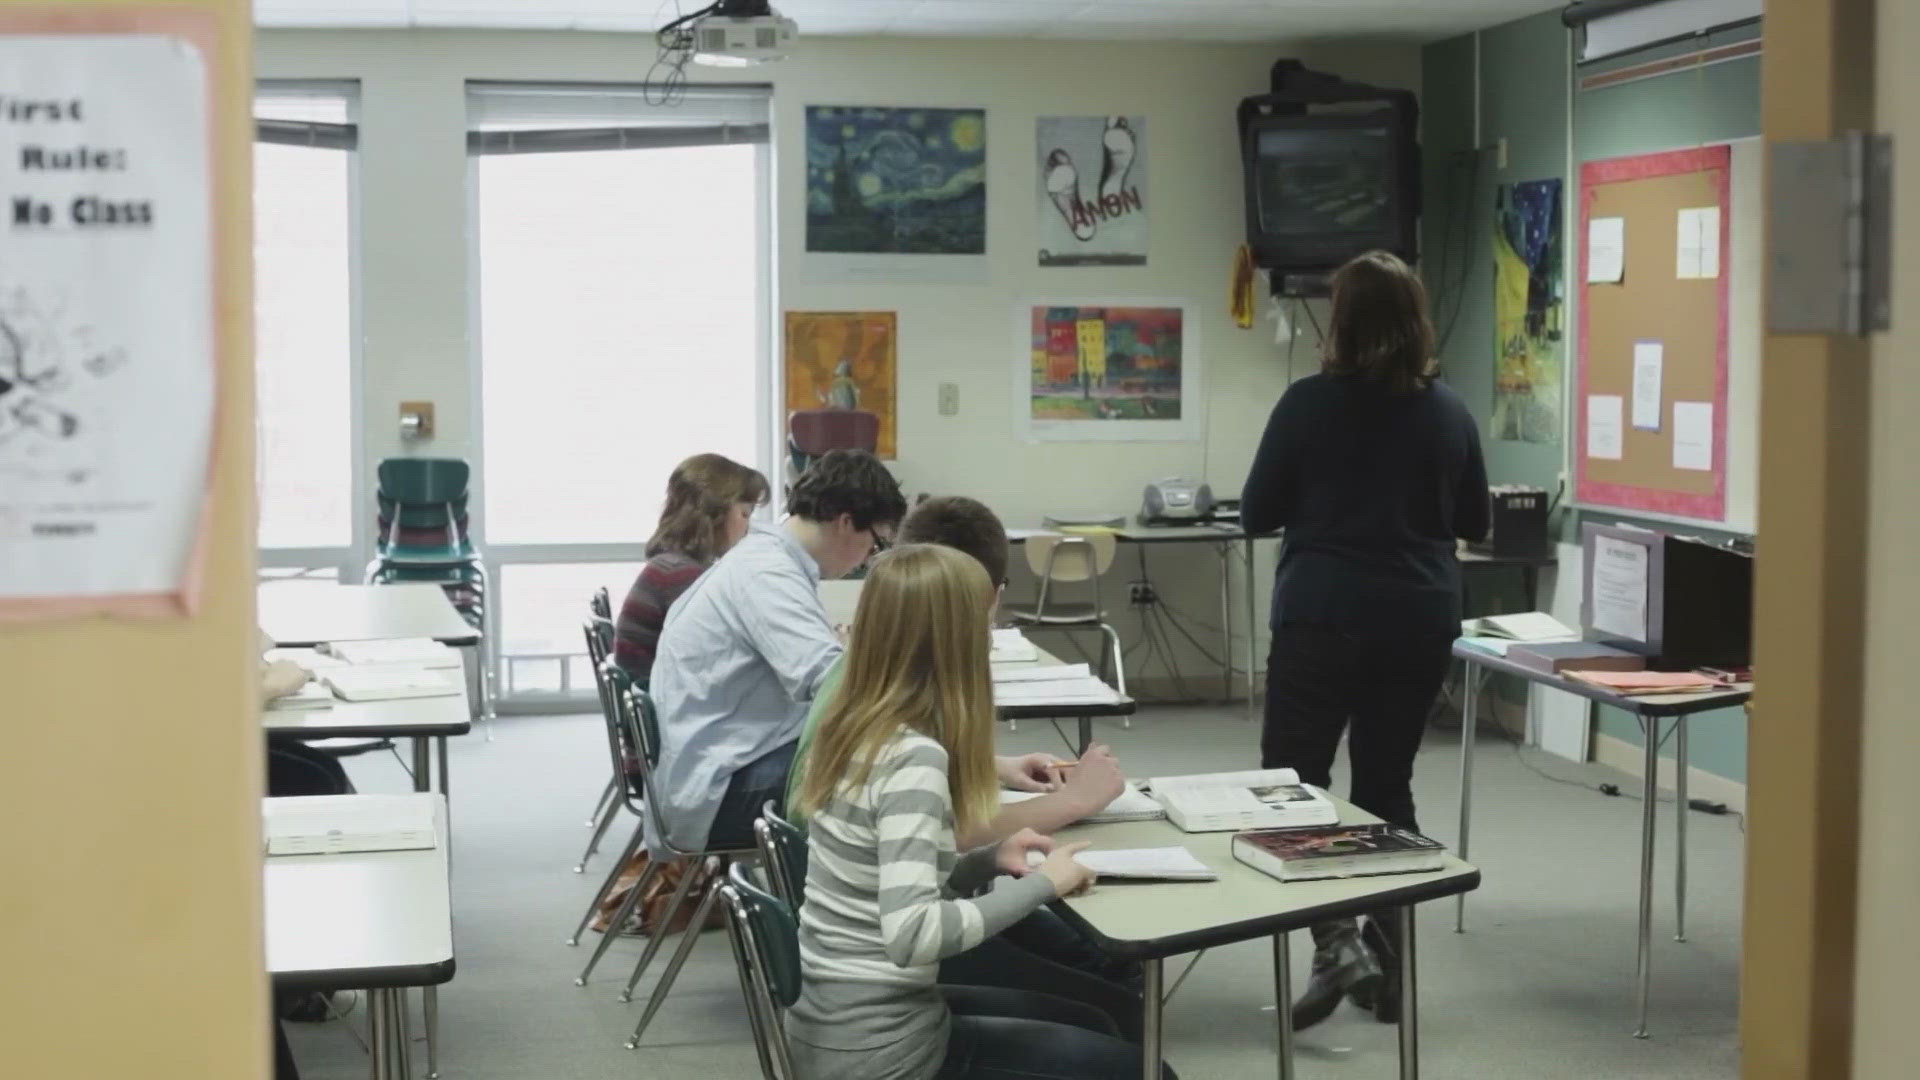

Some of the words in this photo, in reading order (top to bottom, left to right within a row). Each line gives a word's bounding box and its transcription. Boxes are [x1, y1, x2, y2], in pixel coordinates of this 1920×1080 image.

[0, 96, 82, 121] irst
[20, 147, 127, 171] Rule:
[11, 197, 53, 225] No
[71, 196, 153, 226] Class
